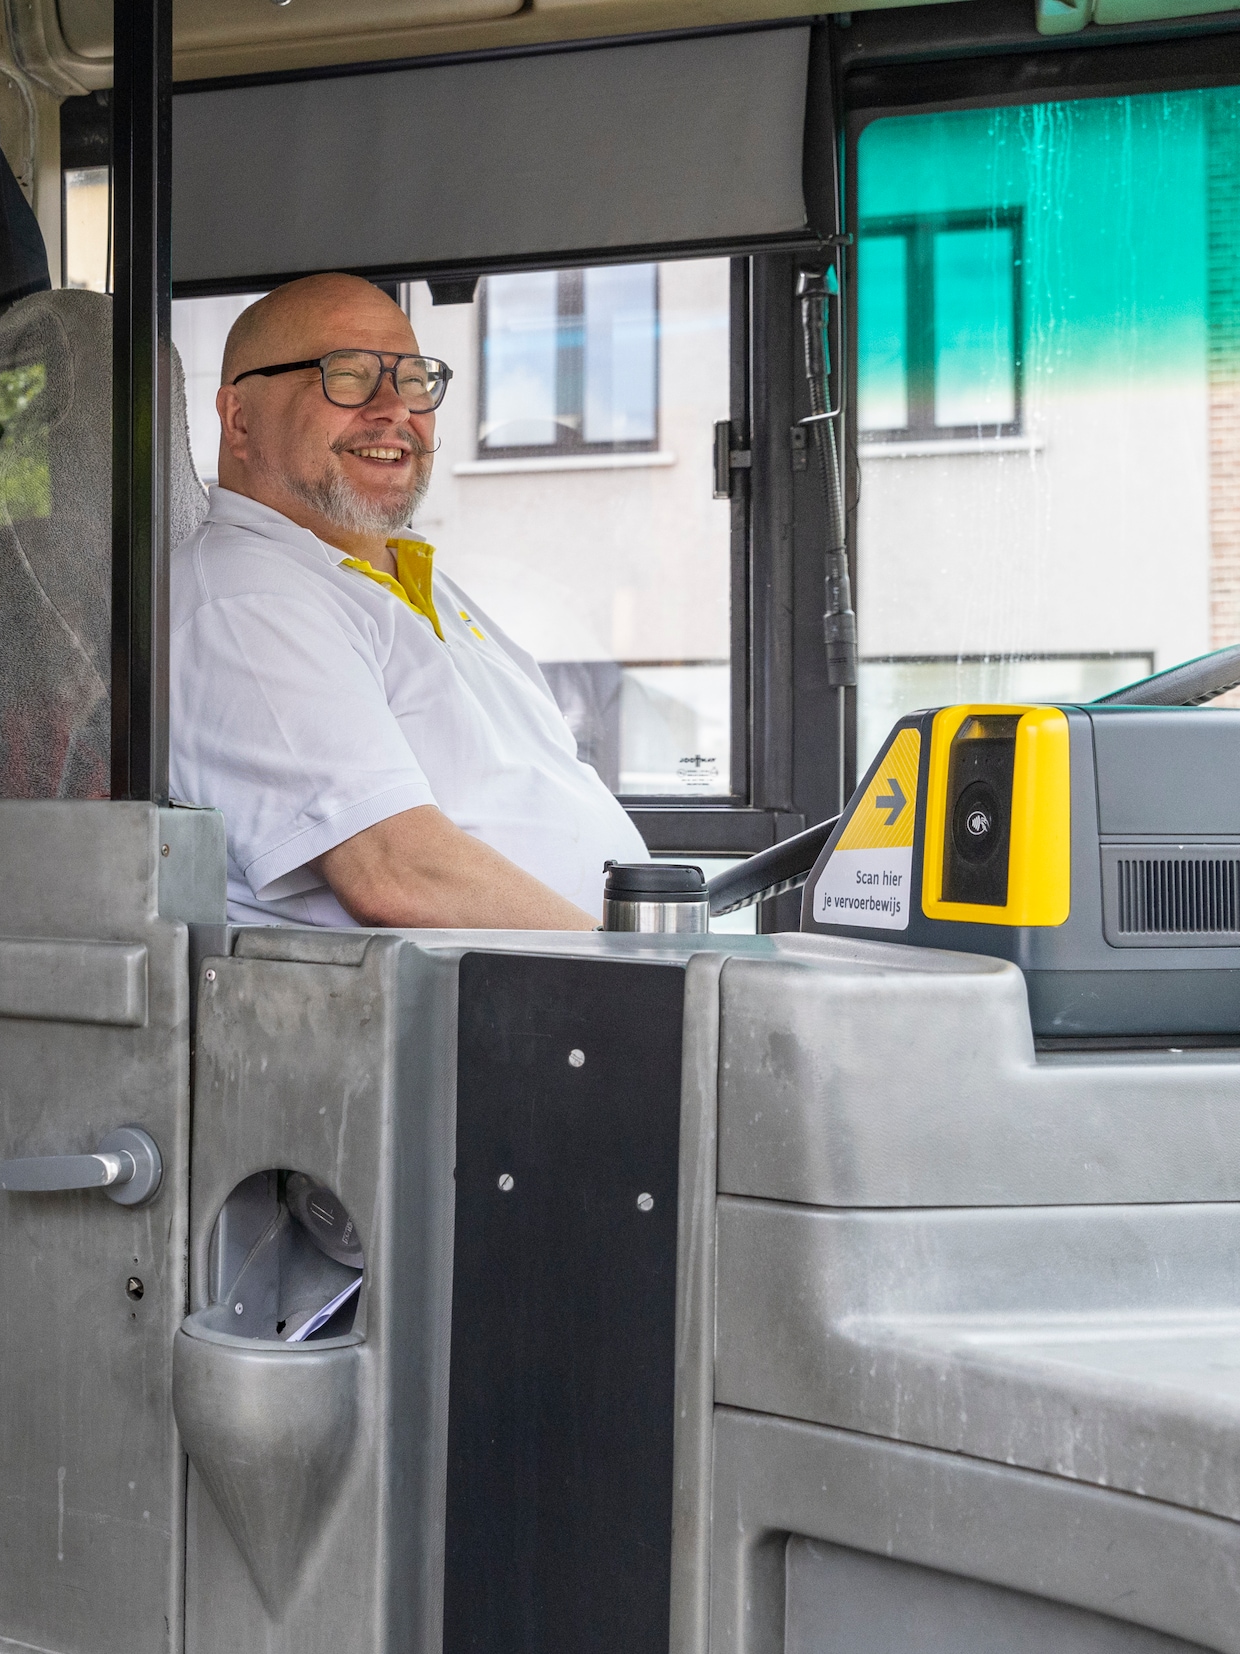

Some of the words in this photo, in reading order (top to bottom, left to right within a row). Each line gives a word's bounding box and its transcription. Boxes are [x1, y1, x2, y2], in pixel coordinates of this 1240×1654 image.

[856, 870, 879, 885] Scan
[882, 870, 903, 887] hier
[822, 892, 832, 911] je
[834, 895, 901, 917] vervoerbewijs
